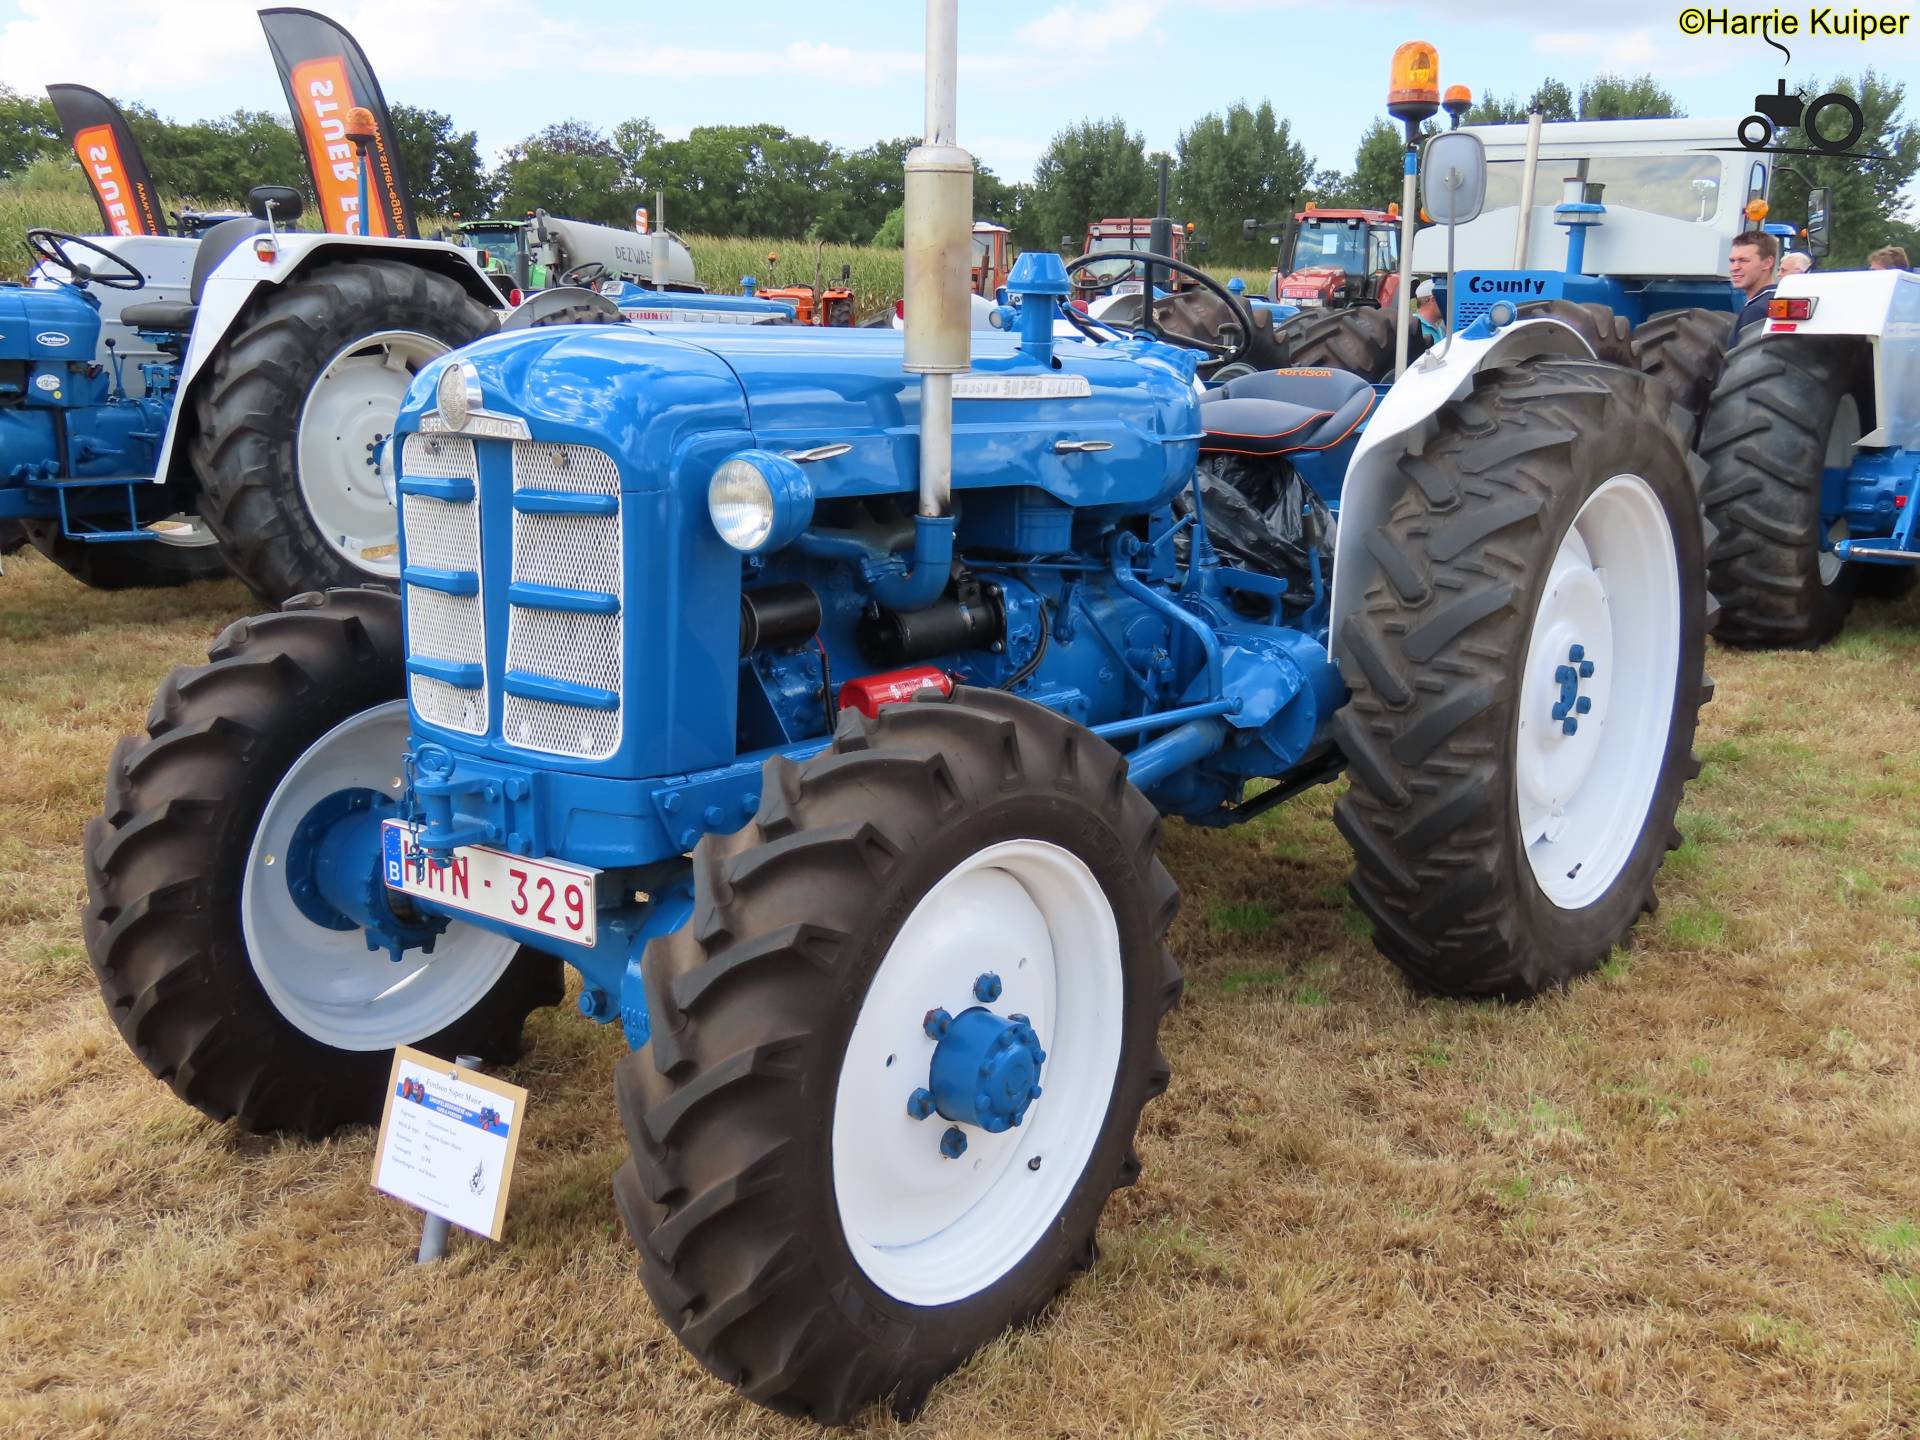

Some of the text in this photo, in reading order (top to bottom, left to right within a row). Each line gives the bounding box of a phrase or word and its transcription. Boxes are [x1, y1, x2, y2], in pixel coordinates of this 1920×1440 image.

[1469, 276, 1545, 295] County
[475, 421, 520, 437] MAJOR
[389, 861, 400, 881] B
[509, 868, 585, 931] 329
